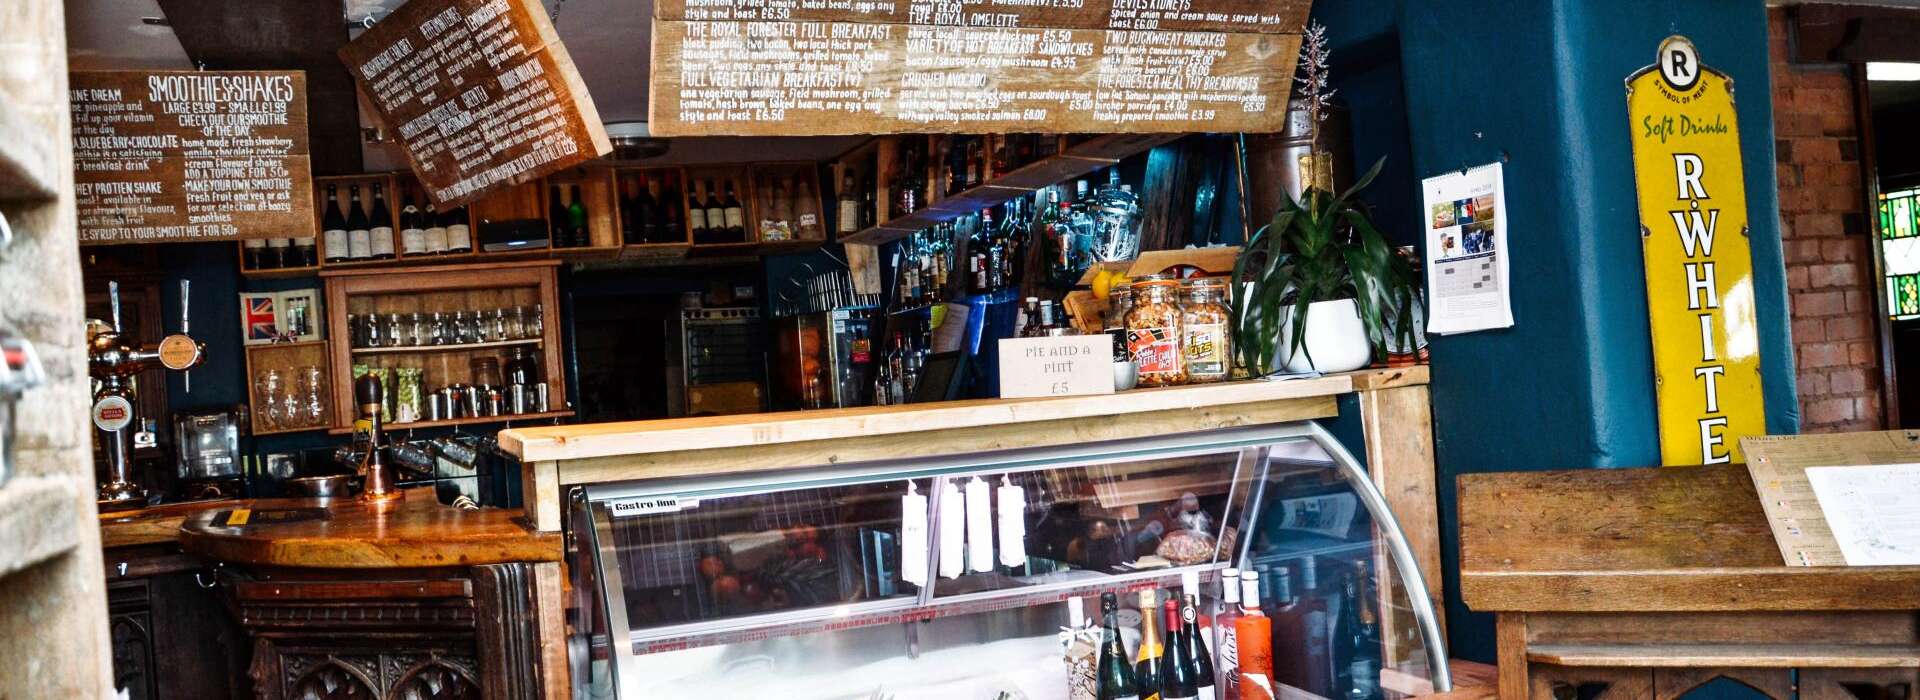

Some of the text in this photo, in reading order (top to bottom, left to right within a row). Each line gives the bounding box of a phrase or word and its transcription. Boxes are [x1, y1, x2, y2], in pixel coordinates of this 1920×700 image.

[685, 9, 789, 21] style and toast £6.50
[908, 12, 1019, 28] THE ROYAL OMELETTE
[1164, 10, 1179, 19] and
[687, 22, 891, 39] THE ROYAL FORESTER FULL BREAKFAST
[1043, 31, 1071, 42] £5.50
[1106, 31, 1226, 47] TWO BUCKWHEAT PANCAKES
[1039, 42, 1093, 55] SANDWICHES
[1671, 50, 1689, 78] R
[681, 72, 842, 87] FULL VEGETARIAN BREAKFAST
[92, 89, 121, 101] DREAM
[1654, 79, 1708, 104] SYMBOL OF MERIT
[127, 101, 142, 111] and
[163, 101, 286, 114] LARGE £3.99 SMALL £1.99
[179, 113, 288, 126] CHECK OUT OUR SMOOTHIE
[680, 110, 784, 123] style and toast £6.50
[1192, 110, 1215, 121] £3.99
[1643, 112, 1728, 145] Soft Drinks
[182, 139, 204, 147] home
[207, 138, 229, 147] made
[83, 161, 150, 172] breakfast drink
[211, 168, 246, 179] TOPPING
[249, 167, 266, 178] FOR
[96, 182, 162, 194] PROTIEN SHAKE
[209, 180, 232, 191] YOUR
[232, 179, 250, 190] OWN
[252, 178, 292, 190] SMOOTHIE
[189, 213, 232, 223] smoothies
[119, 228, 130, 239] TO
[131, 227, 155, 239] YOUR
[204, 226, 220, 237] FOR
[1082, 345, 1091, 355] A
[1052, 382, 1069, 393] £5
